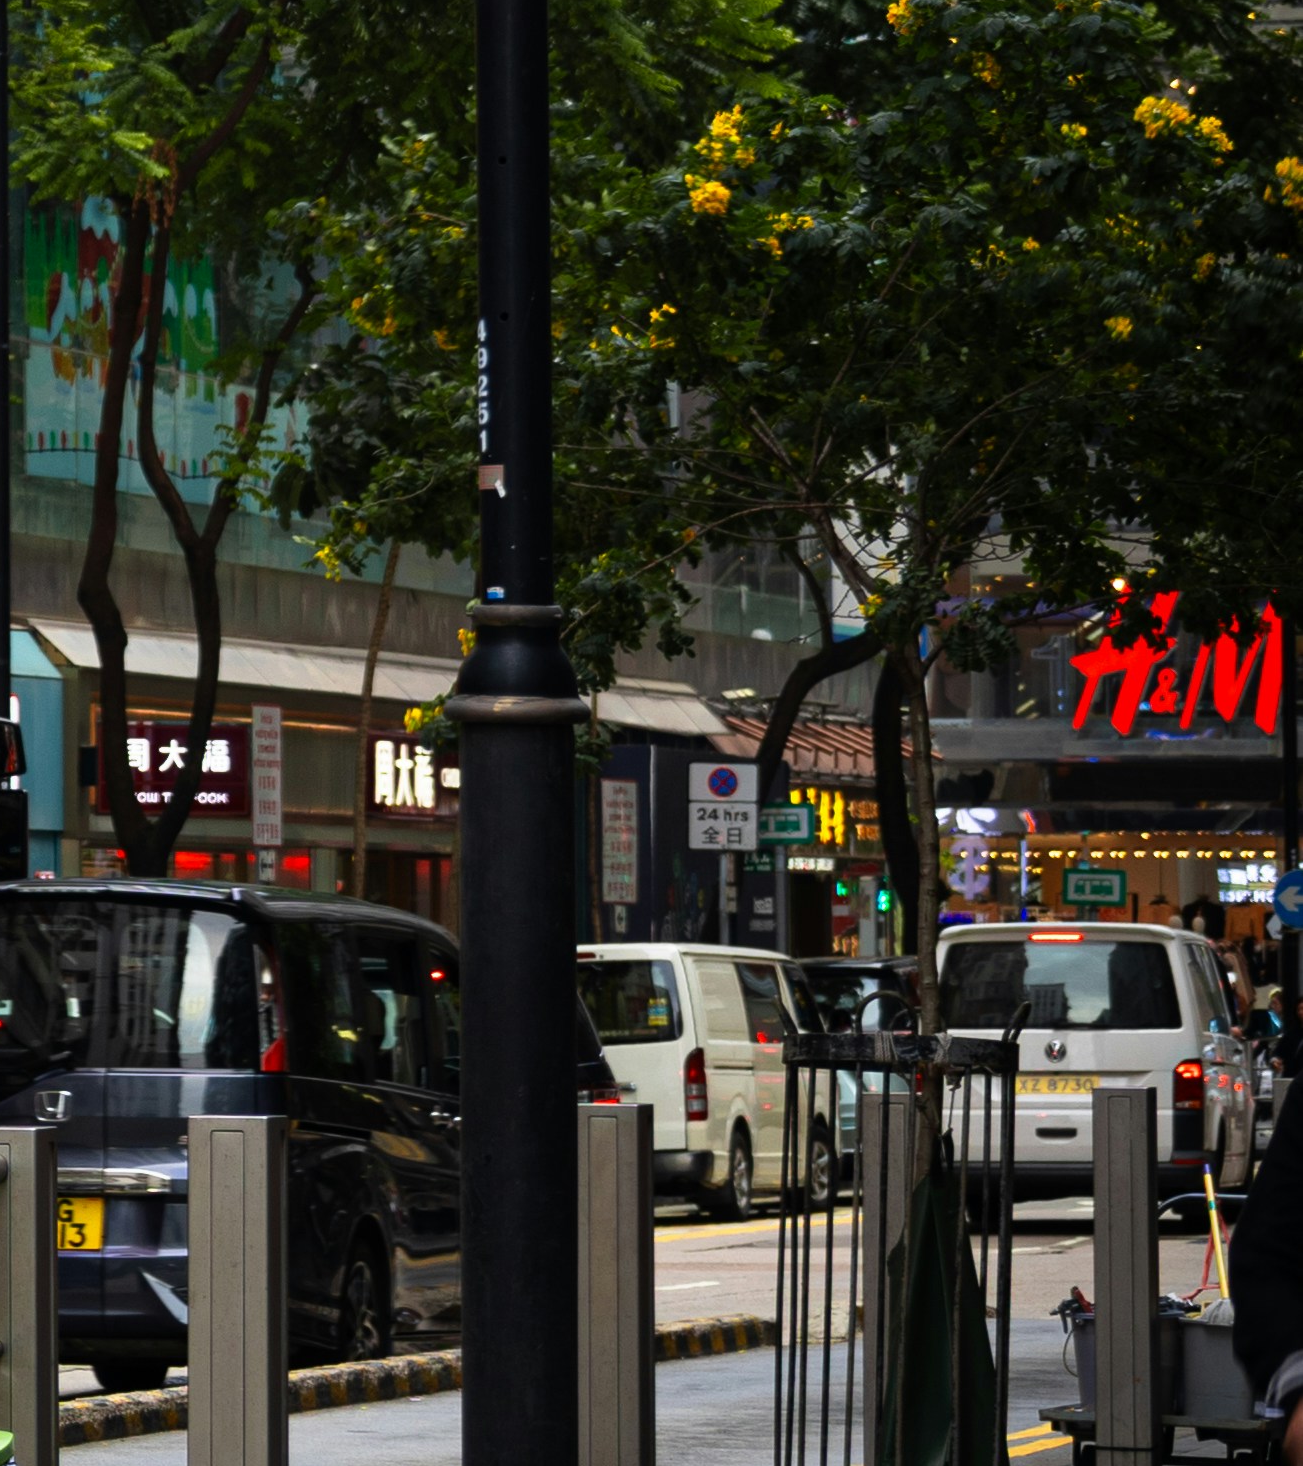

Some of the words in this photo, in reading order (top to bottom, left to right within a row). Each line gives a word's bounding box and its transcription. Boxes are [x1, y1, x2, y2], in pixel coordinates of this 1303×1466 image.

[476, 318, 489, 453] 49251
[1069, 584, 1283, 736] H&M
[696, 807, 719, 822] 24
[723, 809, 749, 822] hrs
[701, 826, 742, 845] 全日
[1019, 1078, 1041, 1093] XZ
[57, 1199, 74, 1223] G
